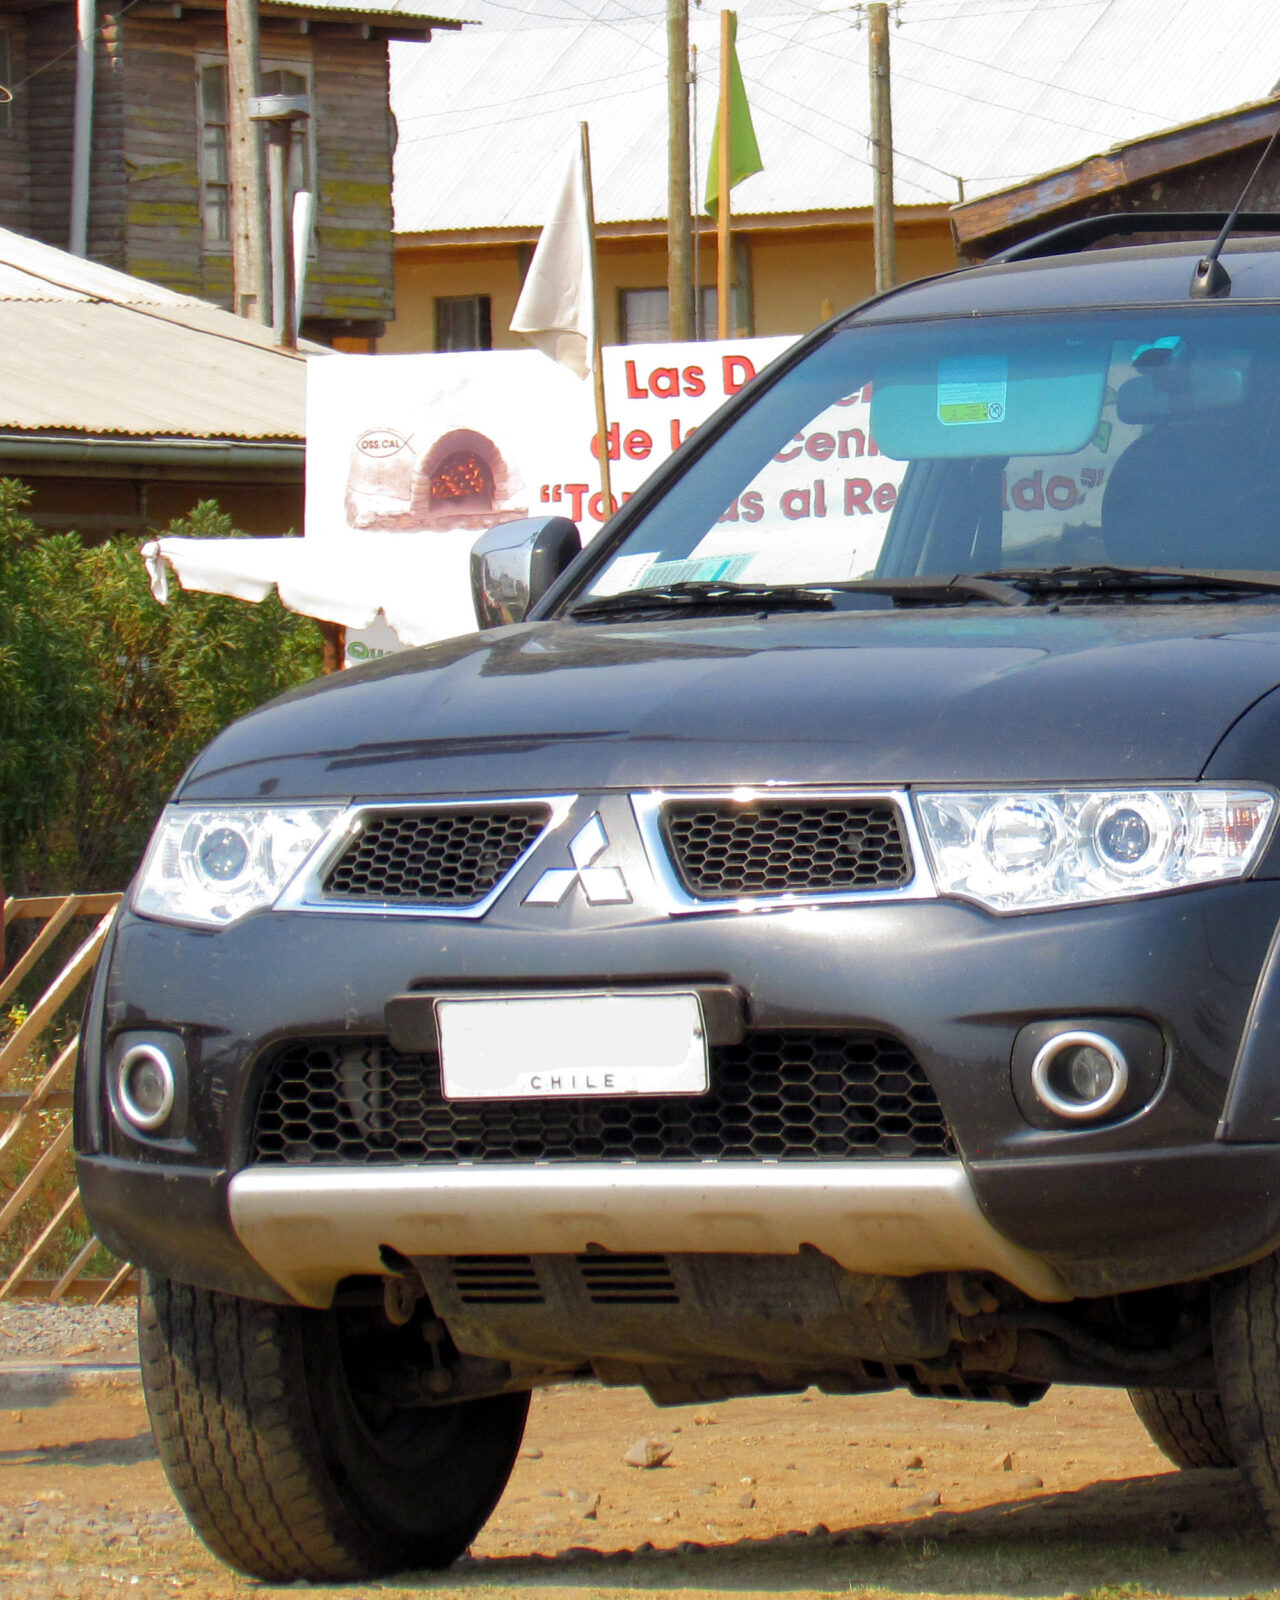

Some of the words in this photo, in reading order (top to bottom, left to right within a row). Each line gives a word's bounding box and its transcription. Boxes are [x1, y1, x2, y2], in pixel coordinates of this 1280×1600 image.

[625, 360, 706, 399] Las
[590, 421, 653, 461] de
[779, 478, 828, 521] al
[530, 1073, 615, 1091] CHILE
